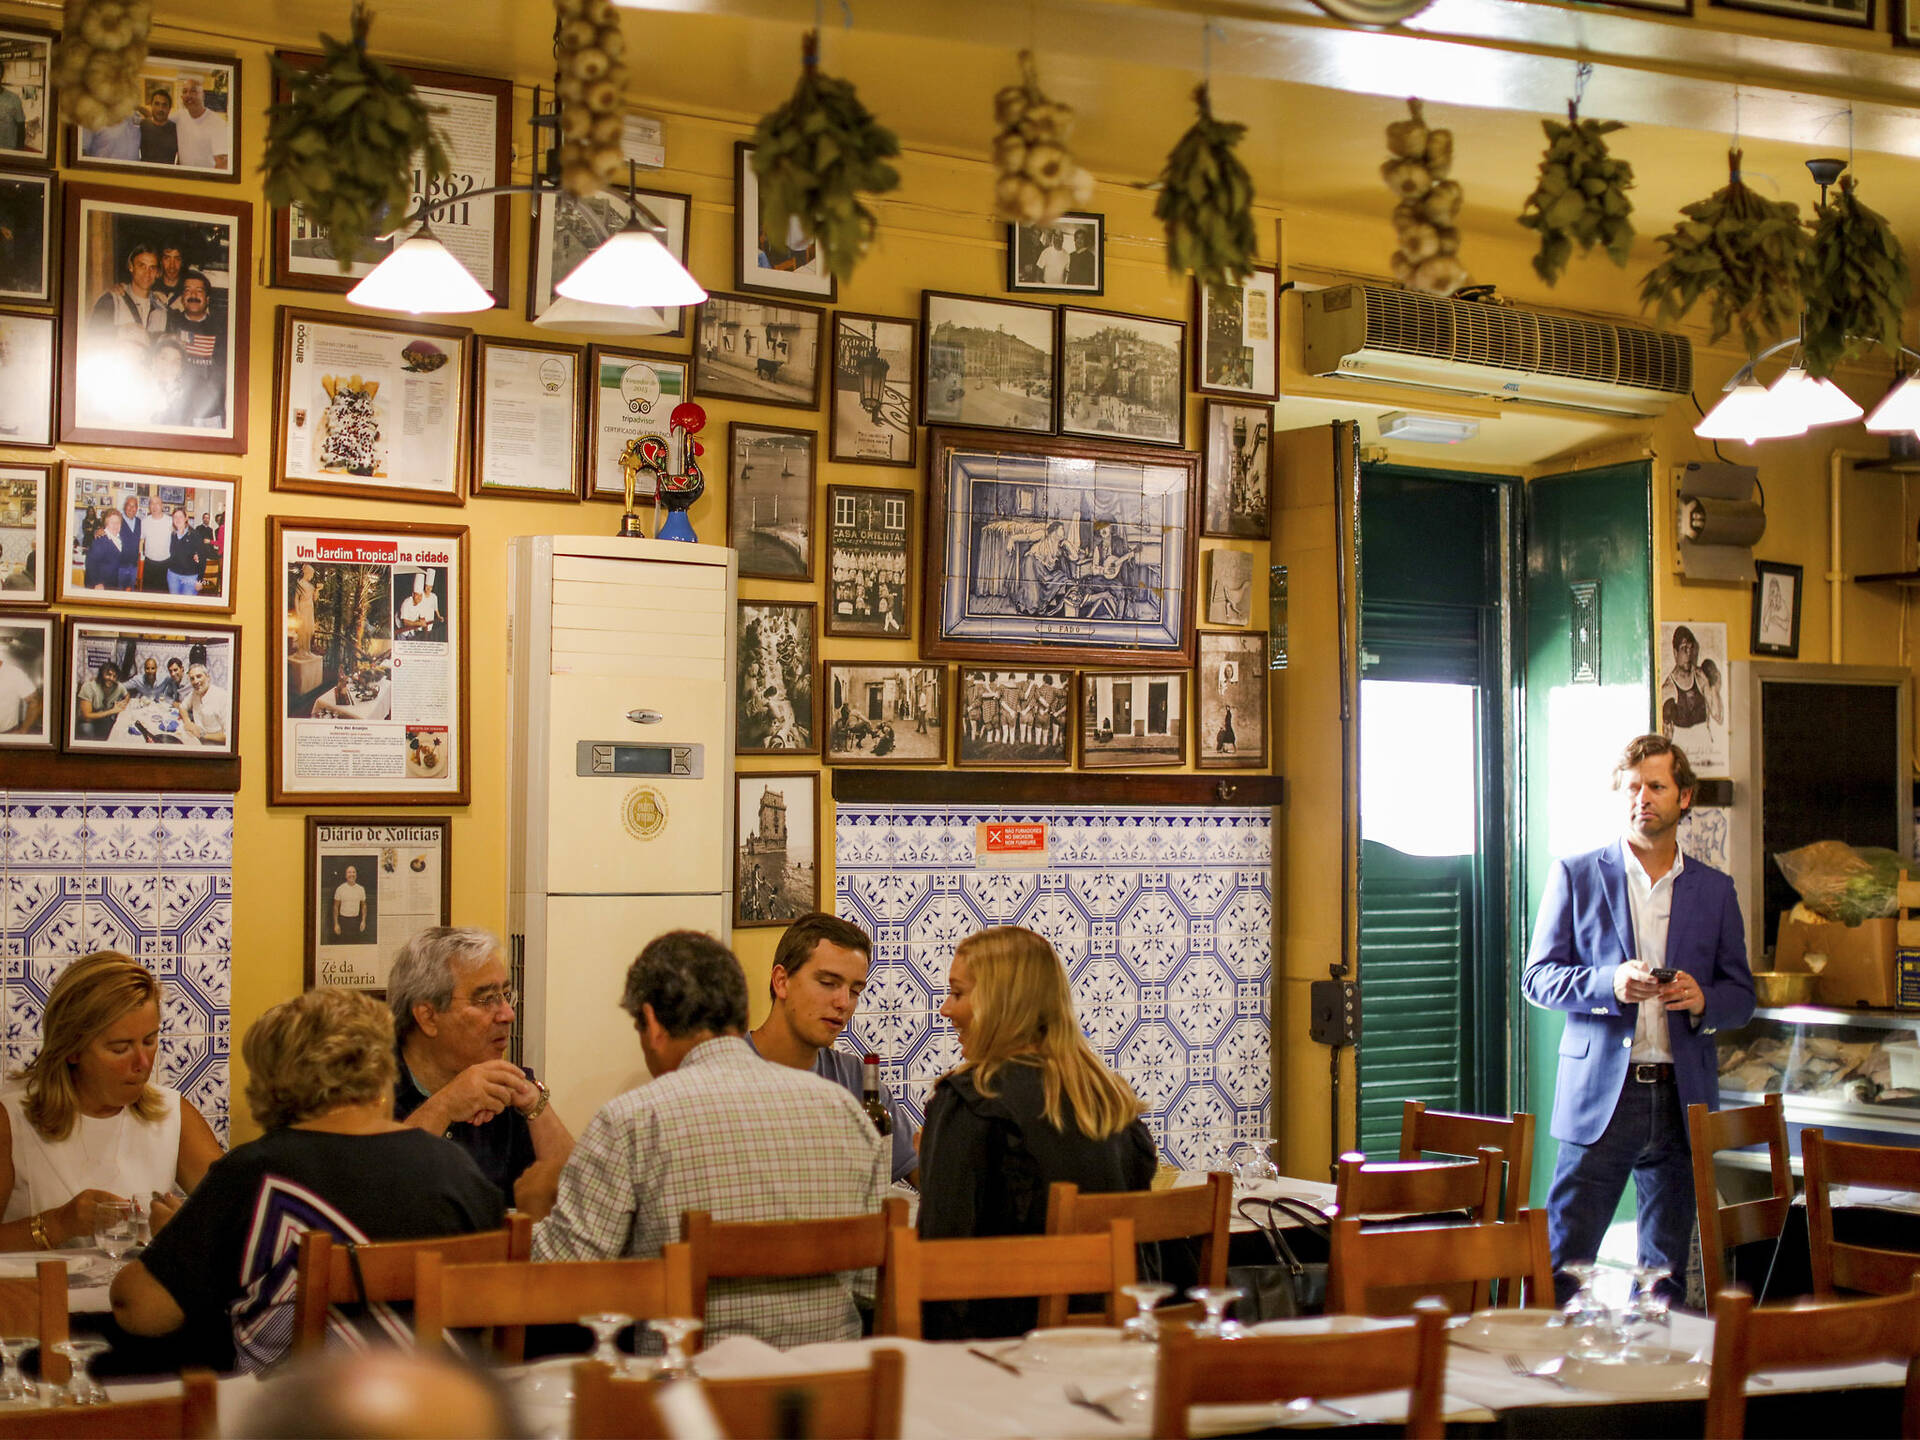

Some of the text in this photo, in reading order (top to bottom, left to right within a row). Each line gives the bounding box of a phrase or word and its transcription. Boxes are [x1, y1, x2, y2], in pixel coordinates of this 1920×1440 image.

[622, 415, 655, 425] tripadvisor
[603, 425, 637, 435] CERTIFICADO
[833, 529, 857, 538] CASA
[861, 532, 905, 542] ORIENTAL
[296, 545, 449, 563] Um Jardim Tropical na cidade
[1059, 624, 1081, 633] FADO
[320, 826, 440, 842] Diário de Notícias
[322, 960, 354, 974] Zé da
[322, 972, 376, 985] Mouraria
